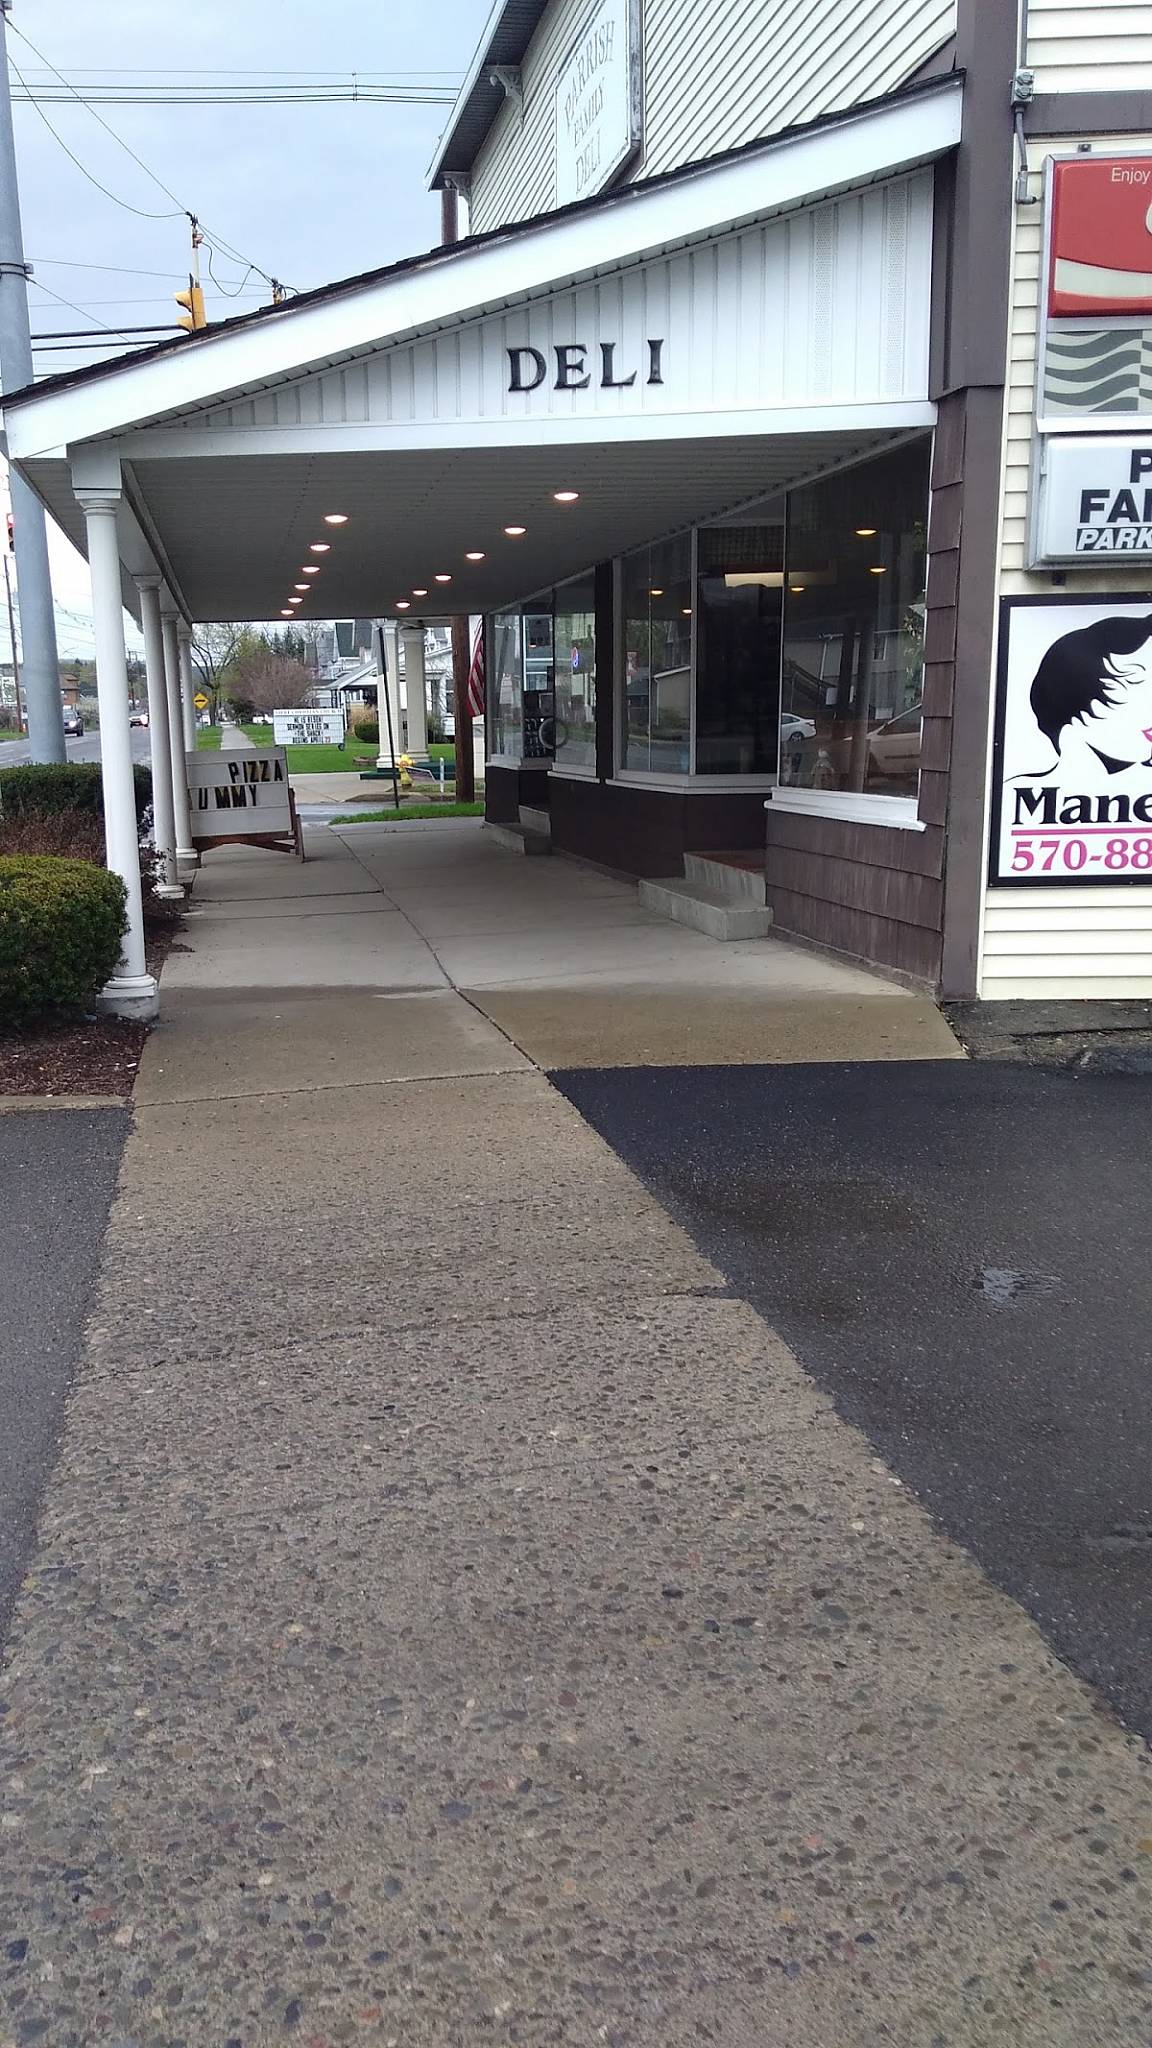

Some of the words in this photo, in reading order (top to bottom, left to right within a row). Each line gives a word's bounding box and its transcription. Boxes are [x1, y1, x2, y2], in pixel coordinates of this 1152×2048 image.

[1111, 167, 1151, 184] Enjoy
[506, 339, 664, 392] DELI
[228, 760, 283, 784] PIZZA
